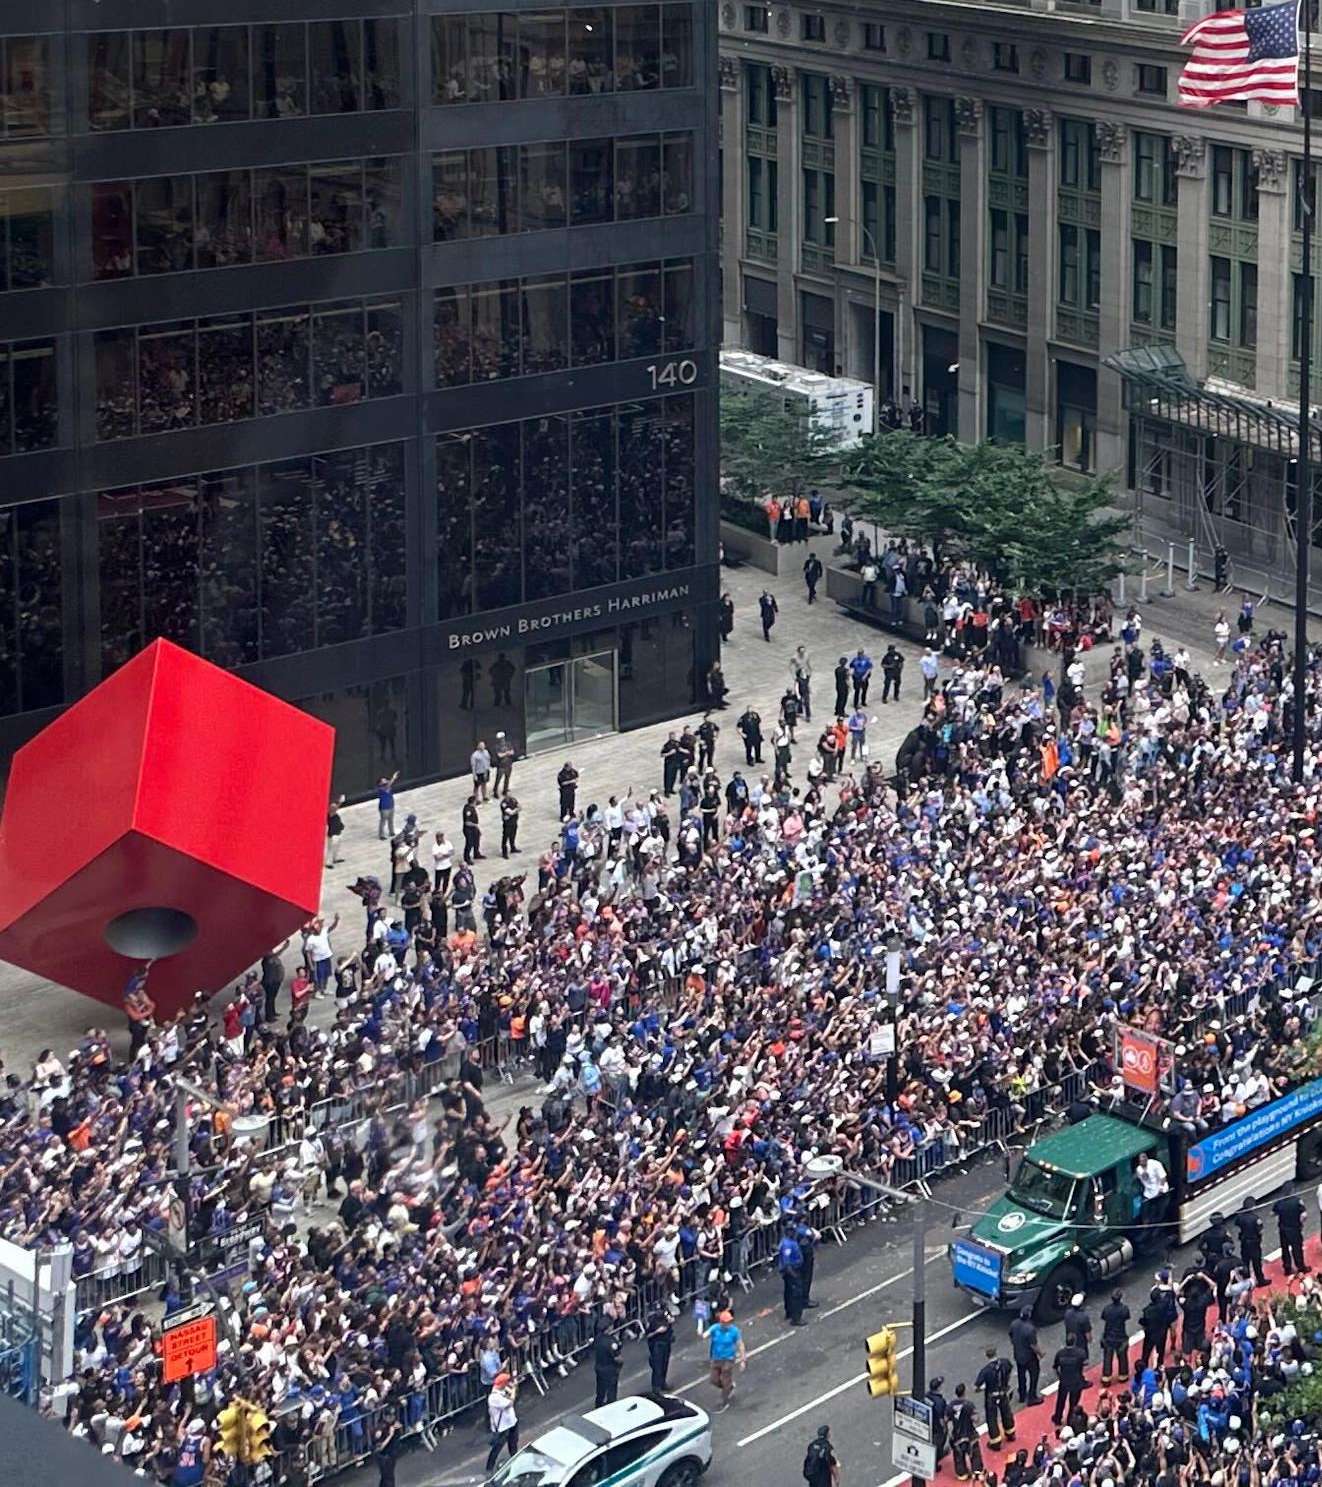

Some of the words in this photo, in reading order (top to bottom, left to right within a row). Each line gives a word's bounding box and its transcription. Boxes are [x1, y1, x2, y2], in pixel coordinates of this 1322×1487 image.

[646, 360, 697, 390] 140
[449, 624, 511, 650] BROWN
[518, 604, 601, 634] BROTHERS
[608, 584, 690, 613] HARRIMAN
[1213, 1129, 1236, 1150] From
[1237, 1119, 1252, 1138] the
[1251, 1094, 1299, 1132] playground
[1213, 1122, 1280, 1164] Congratulations
[1280, 1114, 1293, 1129] NY
[170, 1323, 208, 1341] NASSAU
[171, 1332, 206, 1350] STREET
[171, 1344, 208, 1362] DETOUR
